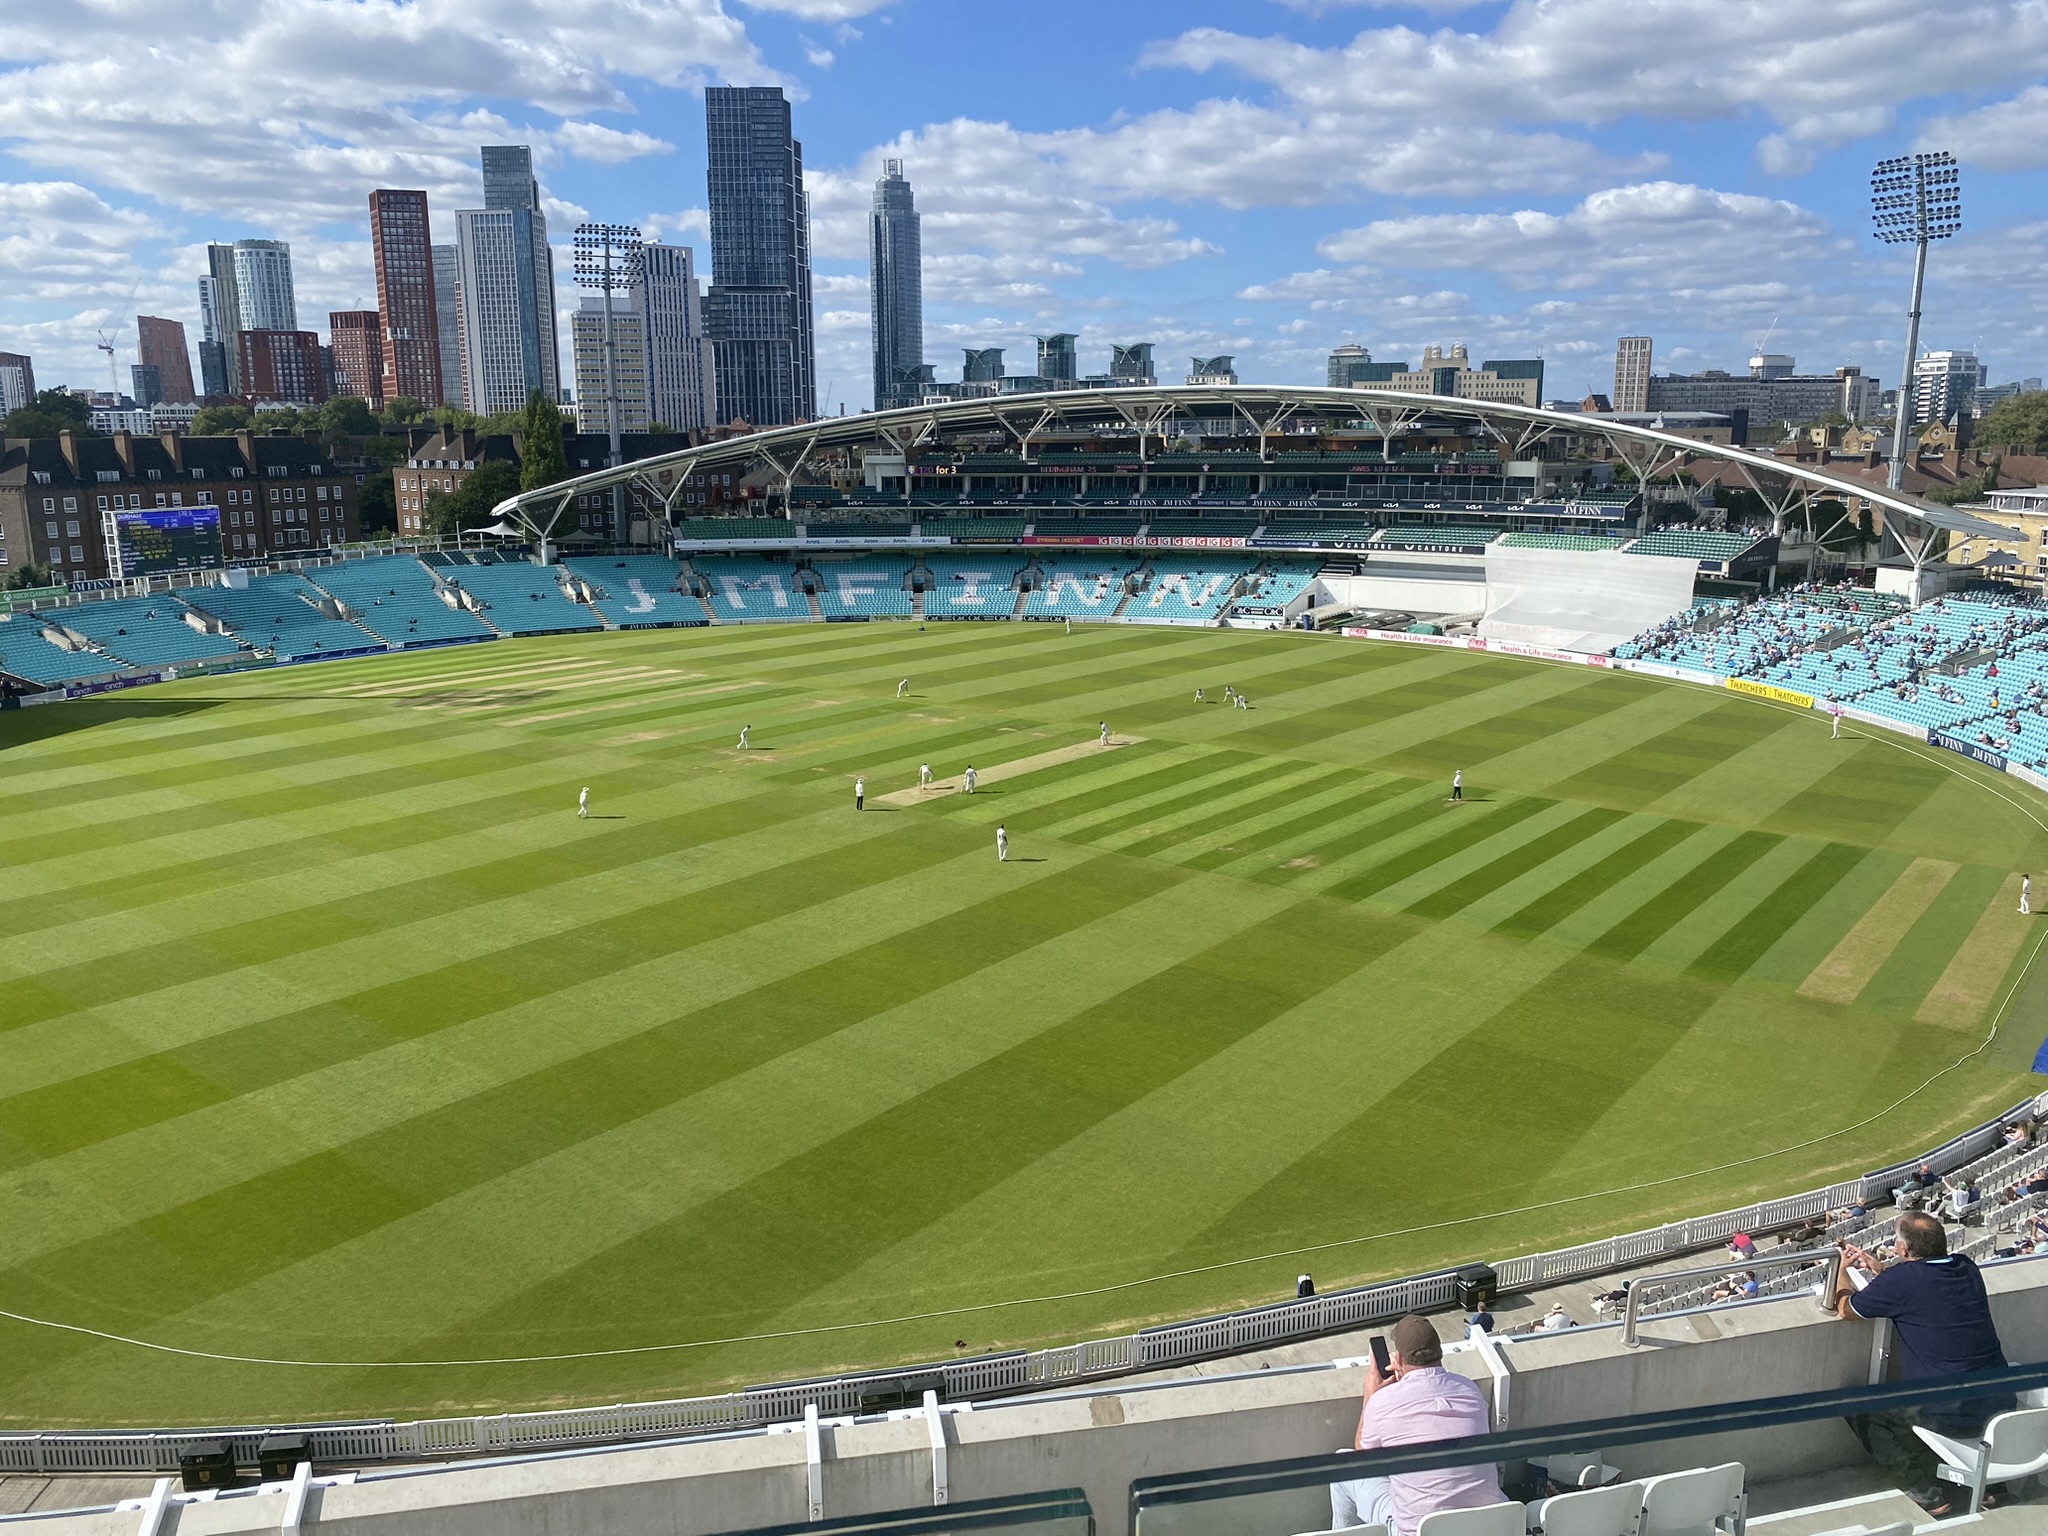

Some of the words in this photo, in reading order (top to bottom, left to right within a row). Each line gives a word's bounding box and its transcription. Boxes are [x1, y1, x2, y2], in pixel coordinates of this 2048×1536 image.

[936, 466, 949, 474] for
[951, 466, 957, 474] 3
[1564, 506, 1577, 515] JM
[1579, 506, 1602, 515] FINN
[1112, 537, 1120, 545] IG
[1123, 537, 1132, 545] IG
[1136, 537, 1145, 545] IG
[1148, 537, 1157, 545] IG
[1160, 537, 1169, 545] IG
[1185, 538, 1194, 546] IG
[1197, 538, 1206, 546] IG
[1210, 538, 1218, 546] IG
[1222, 538, 1231, 546] IG
[1234, 538, 1243, 546] IG
[1347, 542, 1392, 550] CASTORE
[1418, 545, 1463, 553] CASTORE
[70, 583, 85, 592] JM
[88, 582, 111, 590] FINN
[13, 592, 30, 600] XBOX
[30, 590, 47, 598] GAME
[1381, 632, 1402, 641] Health
[1410, 634, 1421, 642] Life
[1501, 645, 1522, 654] Health
[1529, 648, 1541, 656] Life
[1542, 651, 1573, 661] insurance
[136, 676, 156, 685] cinch
[104, 681, 124, 690] cinch
[1730, 680, 1767, 697] THATCHERS
[72, 686, 92, 696] cinch
[1774, 689, 1811, 707] THATCHERS
[1945, 738, 1964, 753] FINN
[1972, 747, 1984, 761] JM
[1984, 752, 2002, 768] FINN
